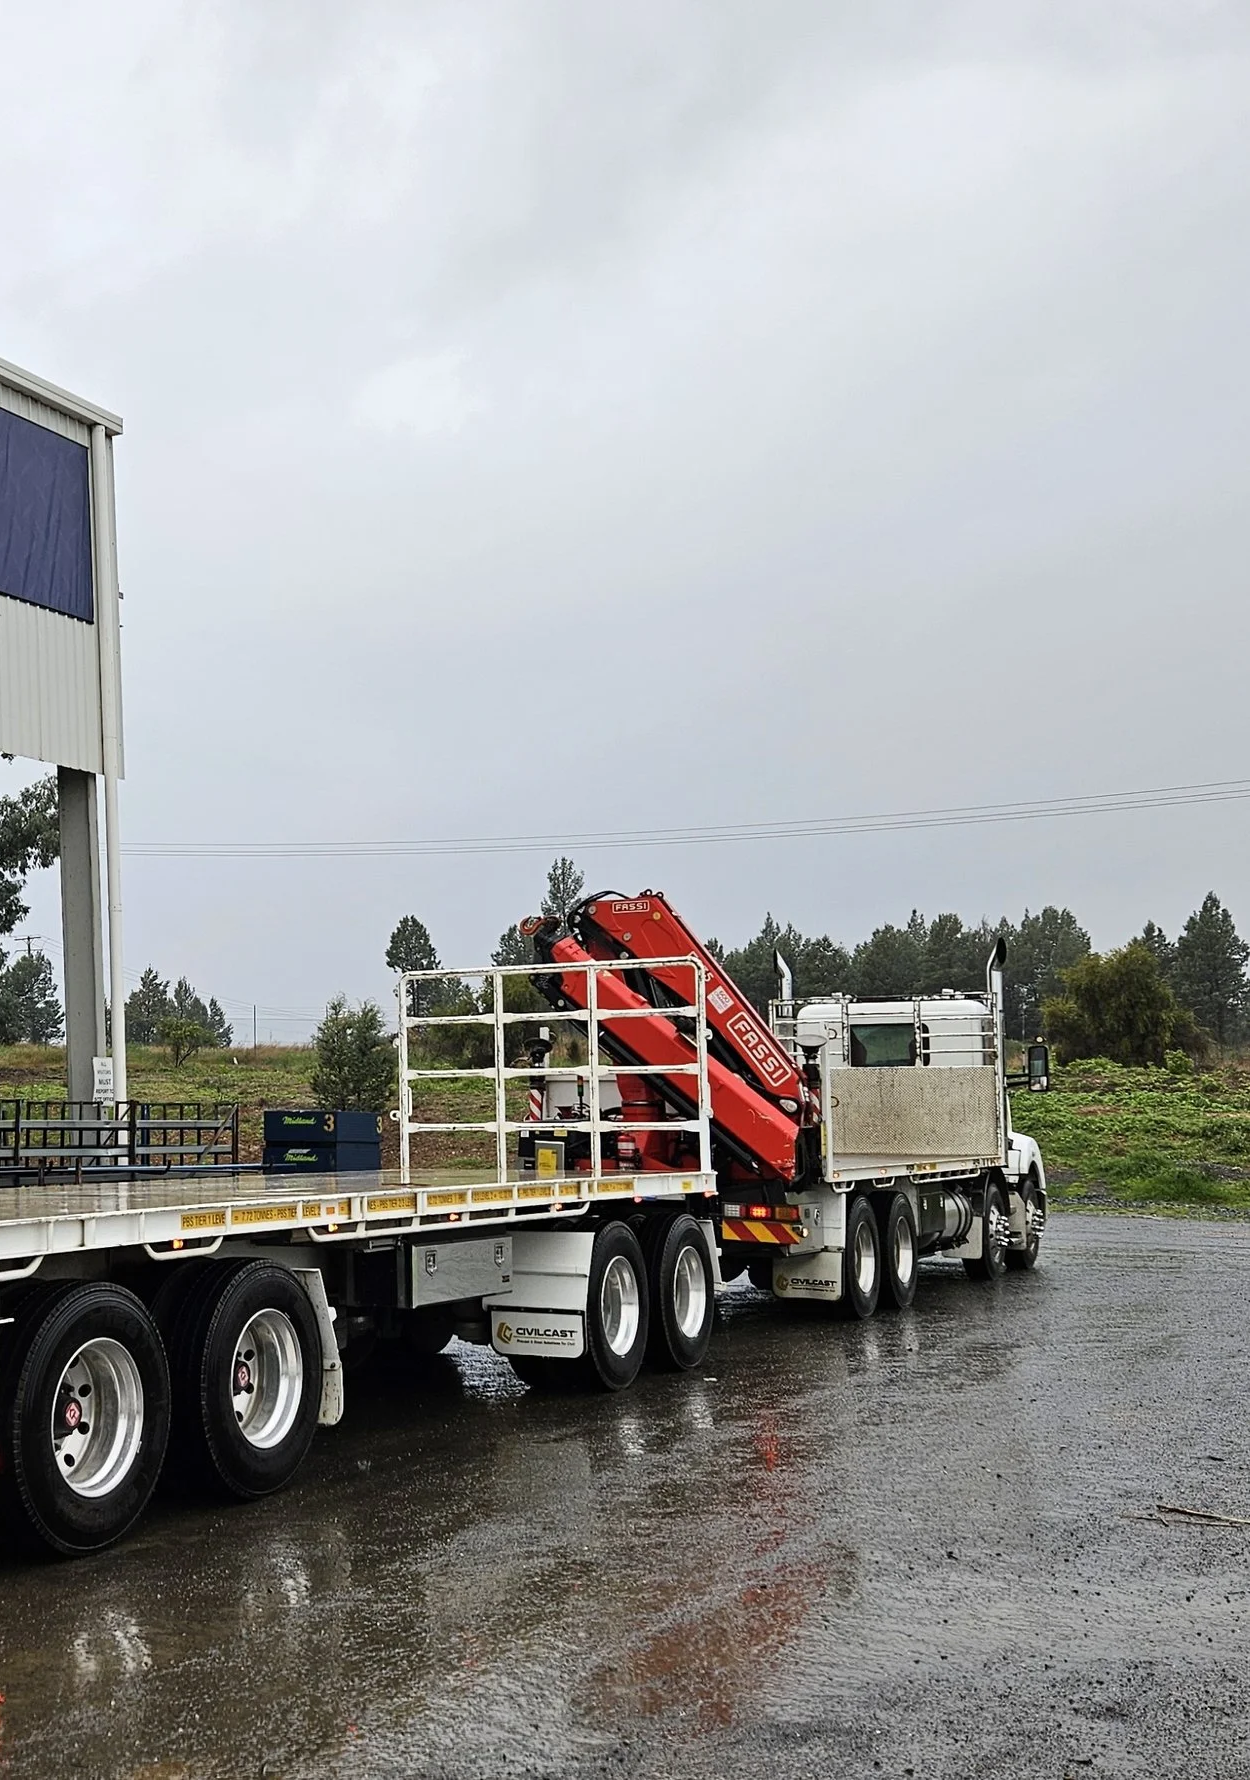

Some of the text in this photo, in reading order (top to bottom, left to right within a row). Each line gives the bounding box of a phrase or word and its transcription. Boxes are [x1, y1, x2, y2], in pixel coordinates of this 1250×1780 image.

[615, 902, 647, 911] FASSI
[733, 1020, 784, 1079] FASSI
[282, 1115, 317, 1125] Midland
[323, 1113, 335, 1132] 3
[376, 1115, 383, 1134] 3
[283, 1152, 318, 1162] Midland
[182, 1216, 194, 1228] PBS
[194, 1214, 207, 1227] TIER
[791, 1278, 837, 1287] CIVILCAST
[516, 1327, 576, 1338] CIVILCAST
